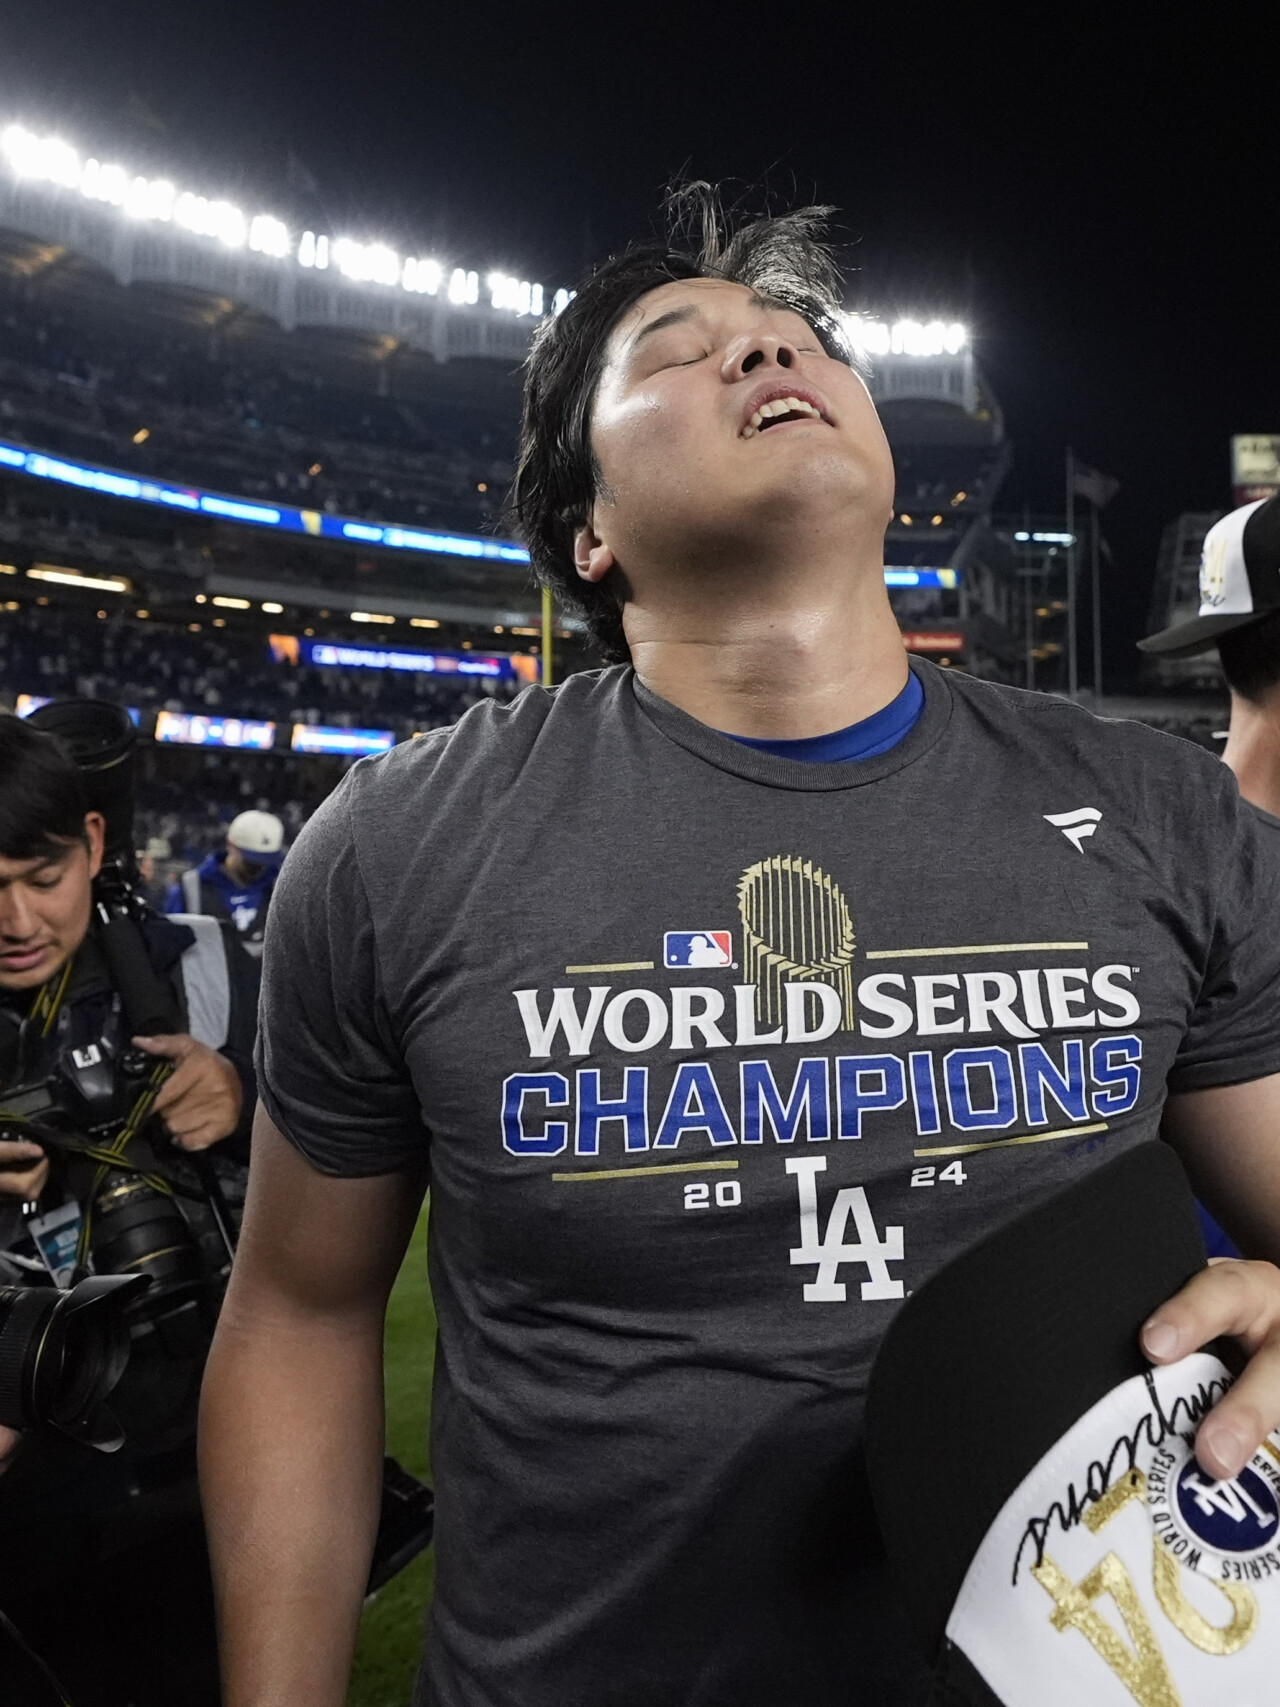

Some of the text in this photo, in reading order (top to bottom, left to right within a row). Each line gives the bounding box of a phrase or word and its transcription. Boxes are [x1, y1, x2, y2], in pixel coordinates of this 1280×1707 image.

[512, 964, 1142, 1057] WORLD SERIES
[501, 1035, 1143, 1157] CHAMPIONS
[683, 1160, 968, 1210] 20 24
[784, 1155, 906, 1303] LA
[1148, 1448, 1202, 1572] WORLD SERIES
[1181, 1472, 1276, 1530] LA
